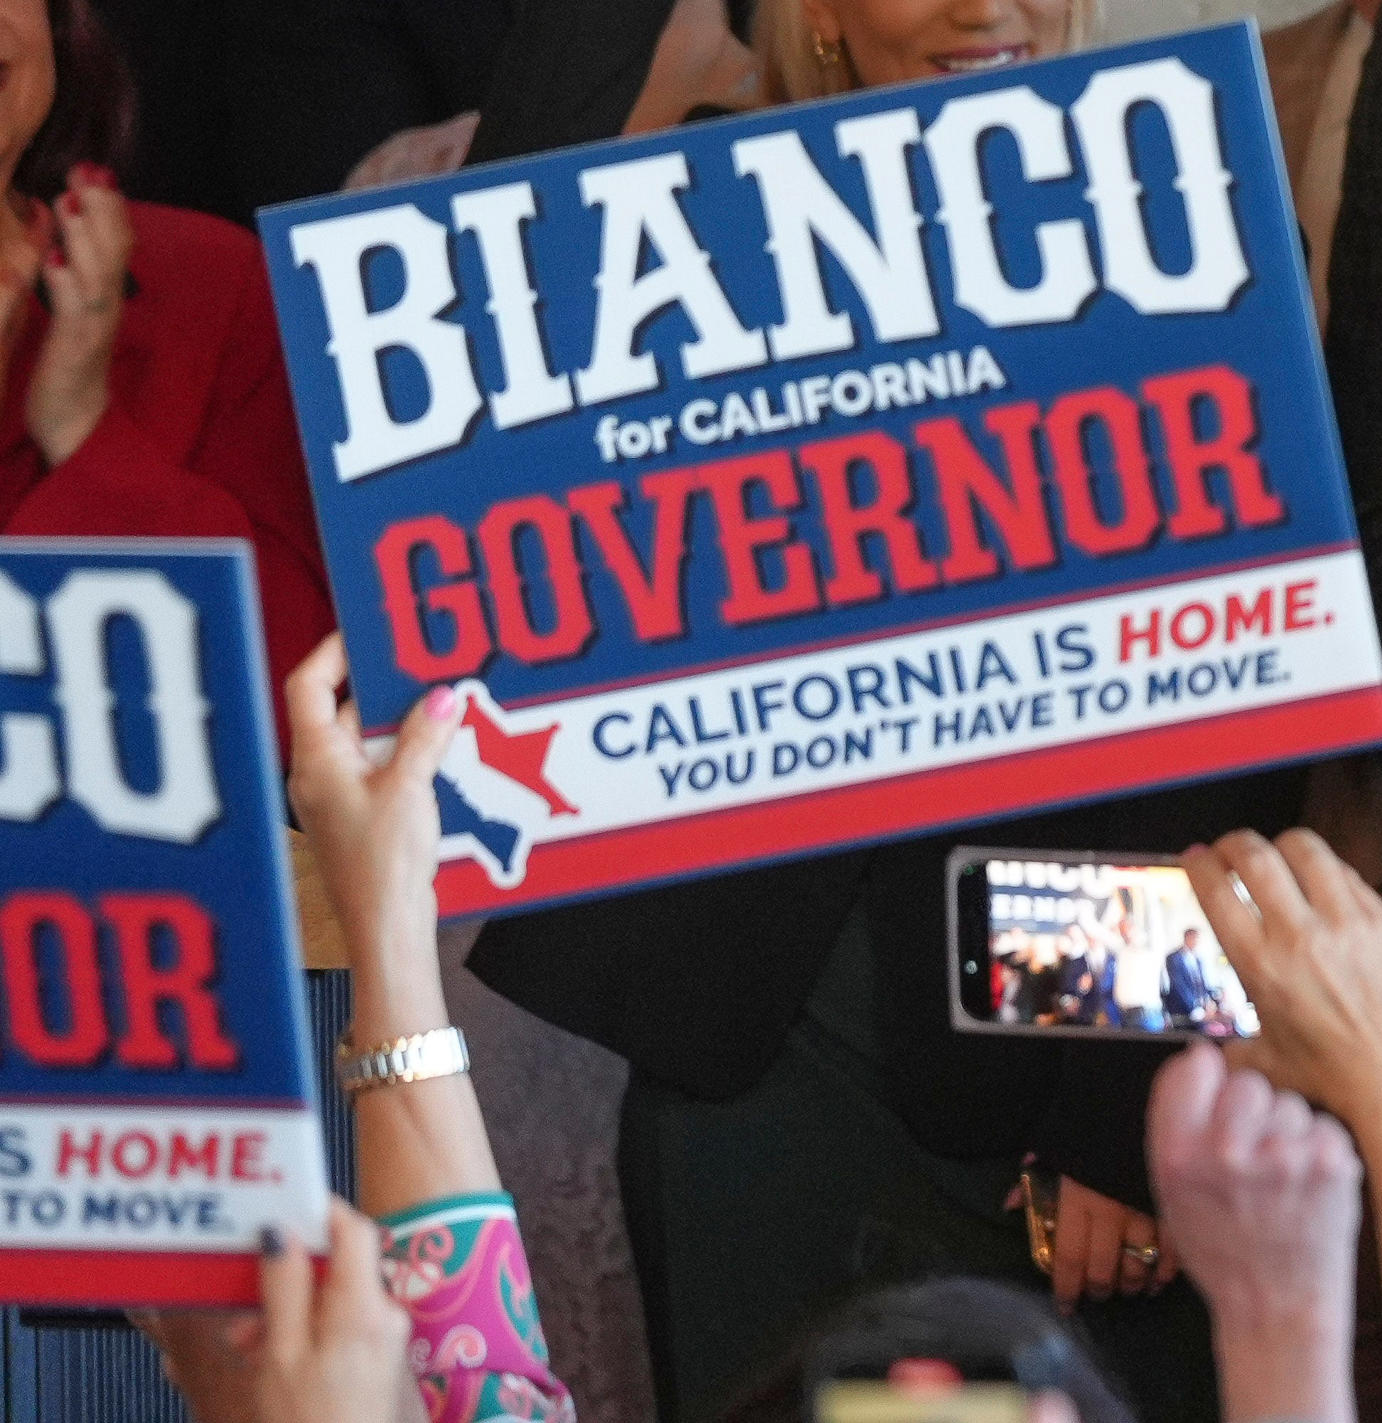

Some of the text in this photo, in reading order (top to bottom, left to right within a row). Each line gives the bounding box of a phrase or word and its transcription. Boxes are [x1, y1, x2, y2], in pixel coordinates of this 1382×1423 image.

[289, 58, 1250, 482] BIANCO
[596, 346, 1005, 462] for CALIFORNIA
[373, 366, 1283, 683] GOVERNOR
[590, 579, 1335, 761] CALIFORNIA IS HOME.
[657, 649, 1293, 799] YOU DON'T HAVE TO MOVE.
[0, 890, 239, 1071] OR
[1, 1190, 236, 1235] TO MOVE.
[55, 1127, 284, 1184] HOME.
